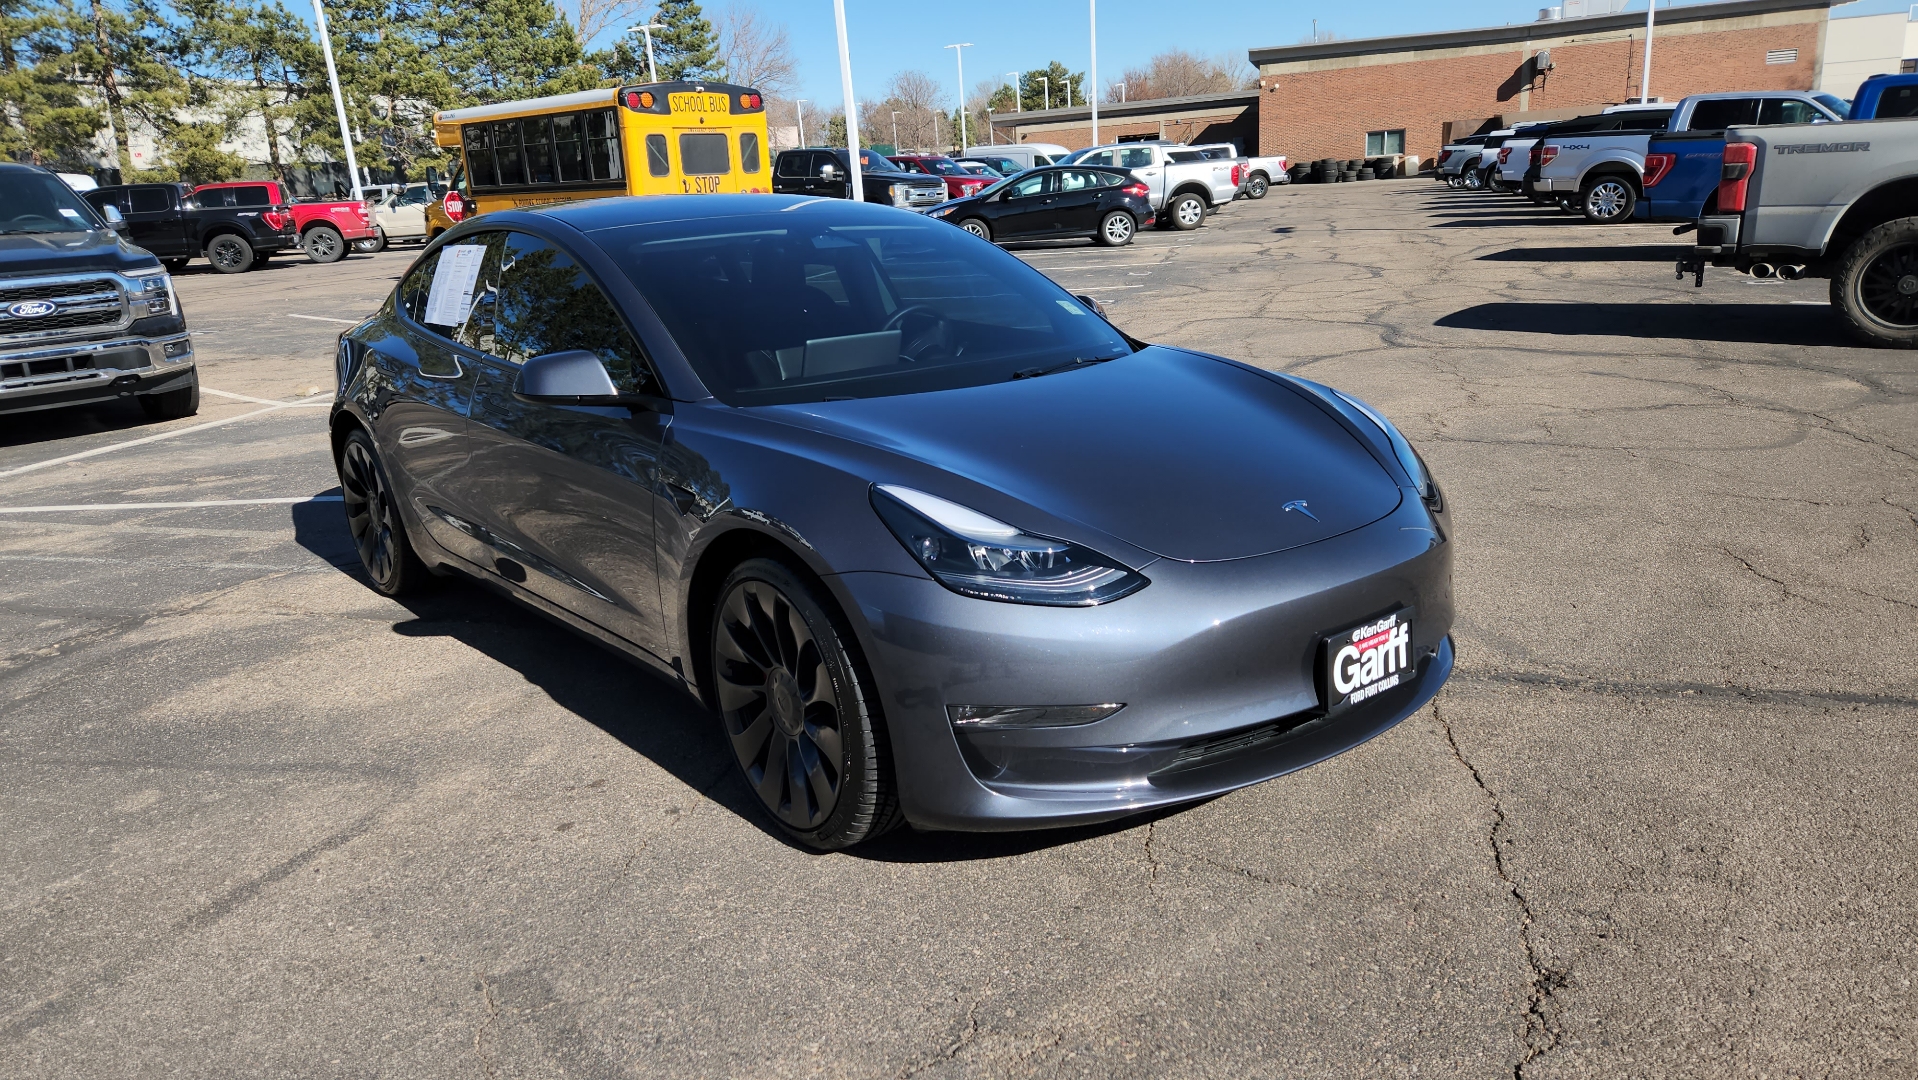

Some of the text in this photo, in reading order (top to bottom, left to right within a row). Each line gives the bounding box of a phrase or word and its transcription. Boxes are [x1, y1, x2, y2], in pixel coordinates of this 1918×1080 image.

[672, 96, 727, 112] SCHOOL BUS
[1773, 141, 1871, 155] TREMOR
[694, 175, 721, 194] STOP
[446, 200, 464, 213] STOP
[1360, 624, 1377, 641] Ken
[1376, 613, 1397, 633] Garff
[1333, 622, 1409, 695] Garff
[1350, 674, 1400, 705] FORD FORT COLLINS
